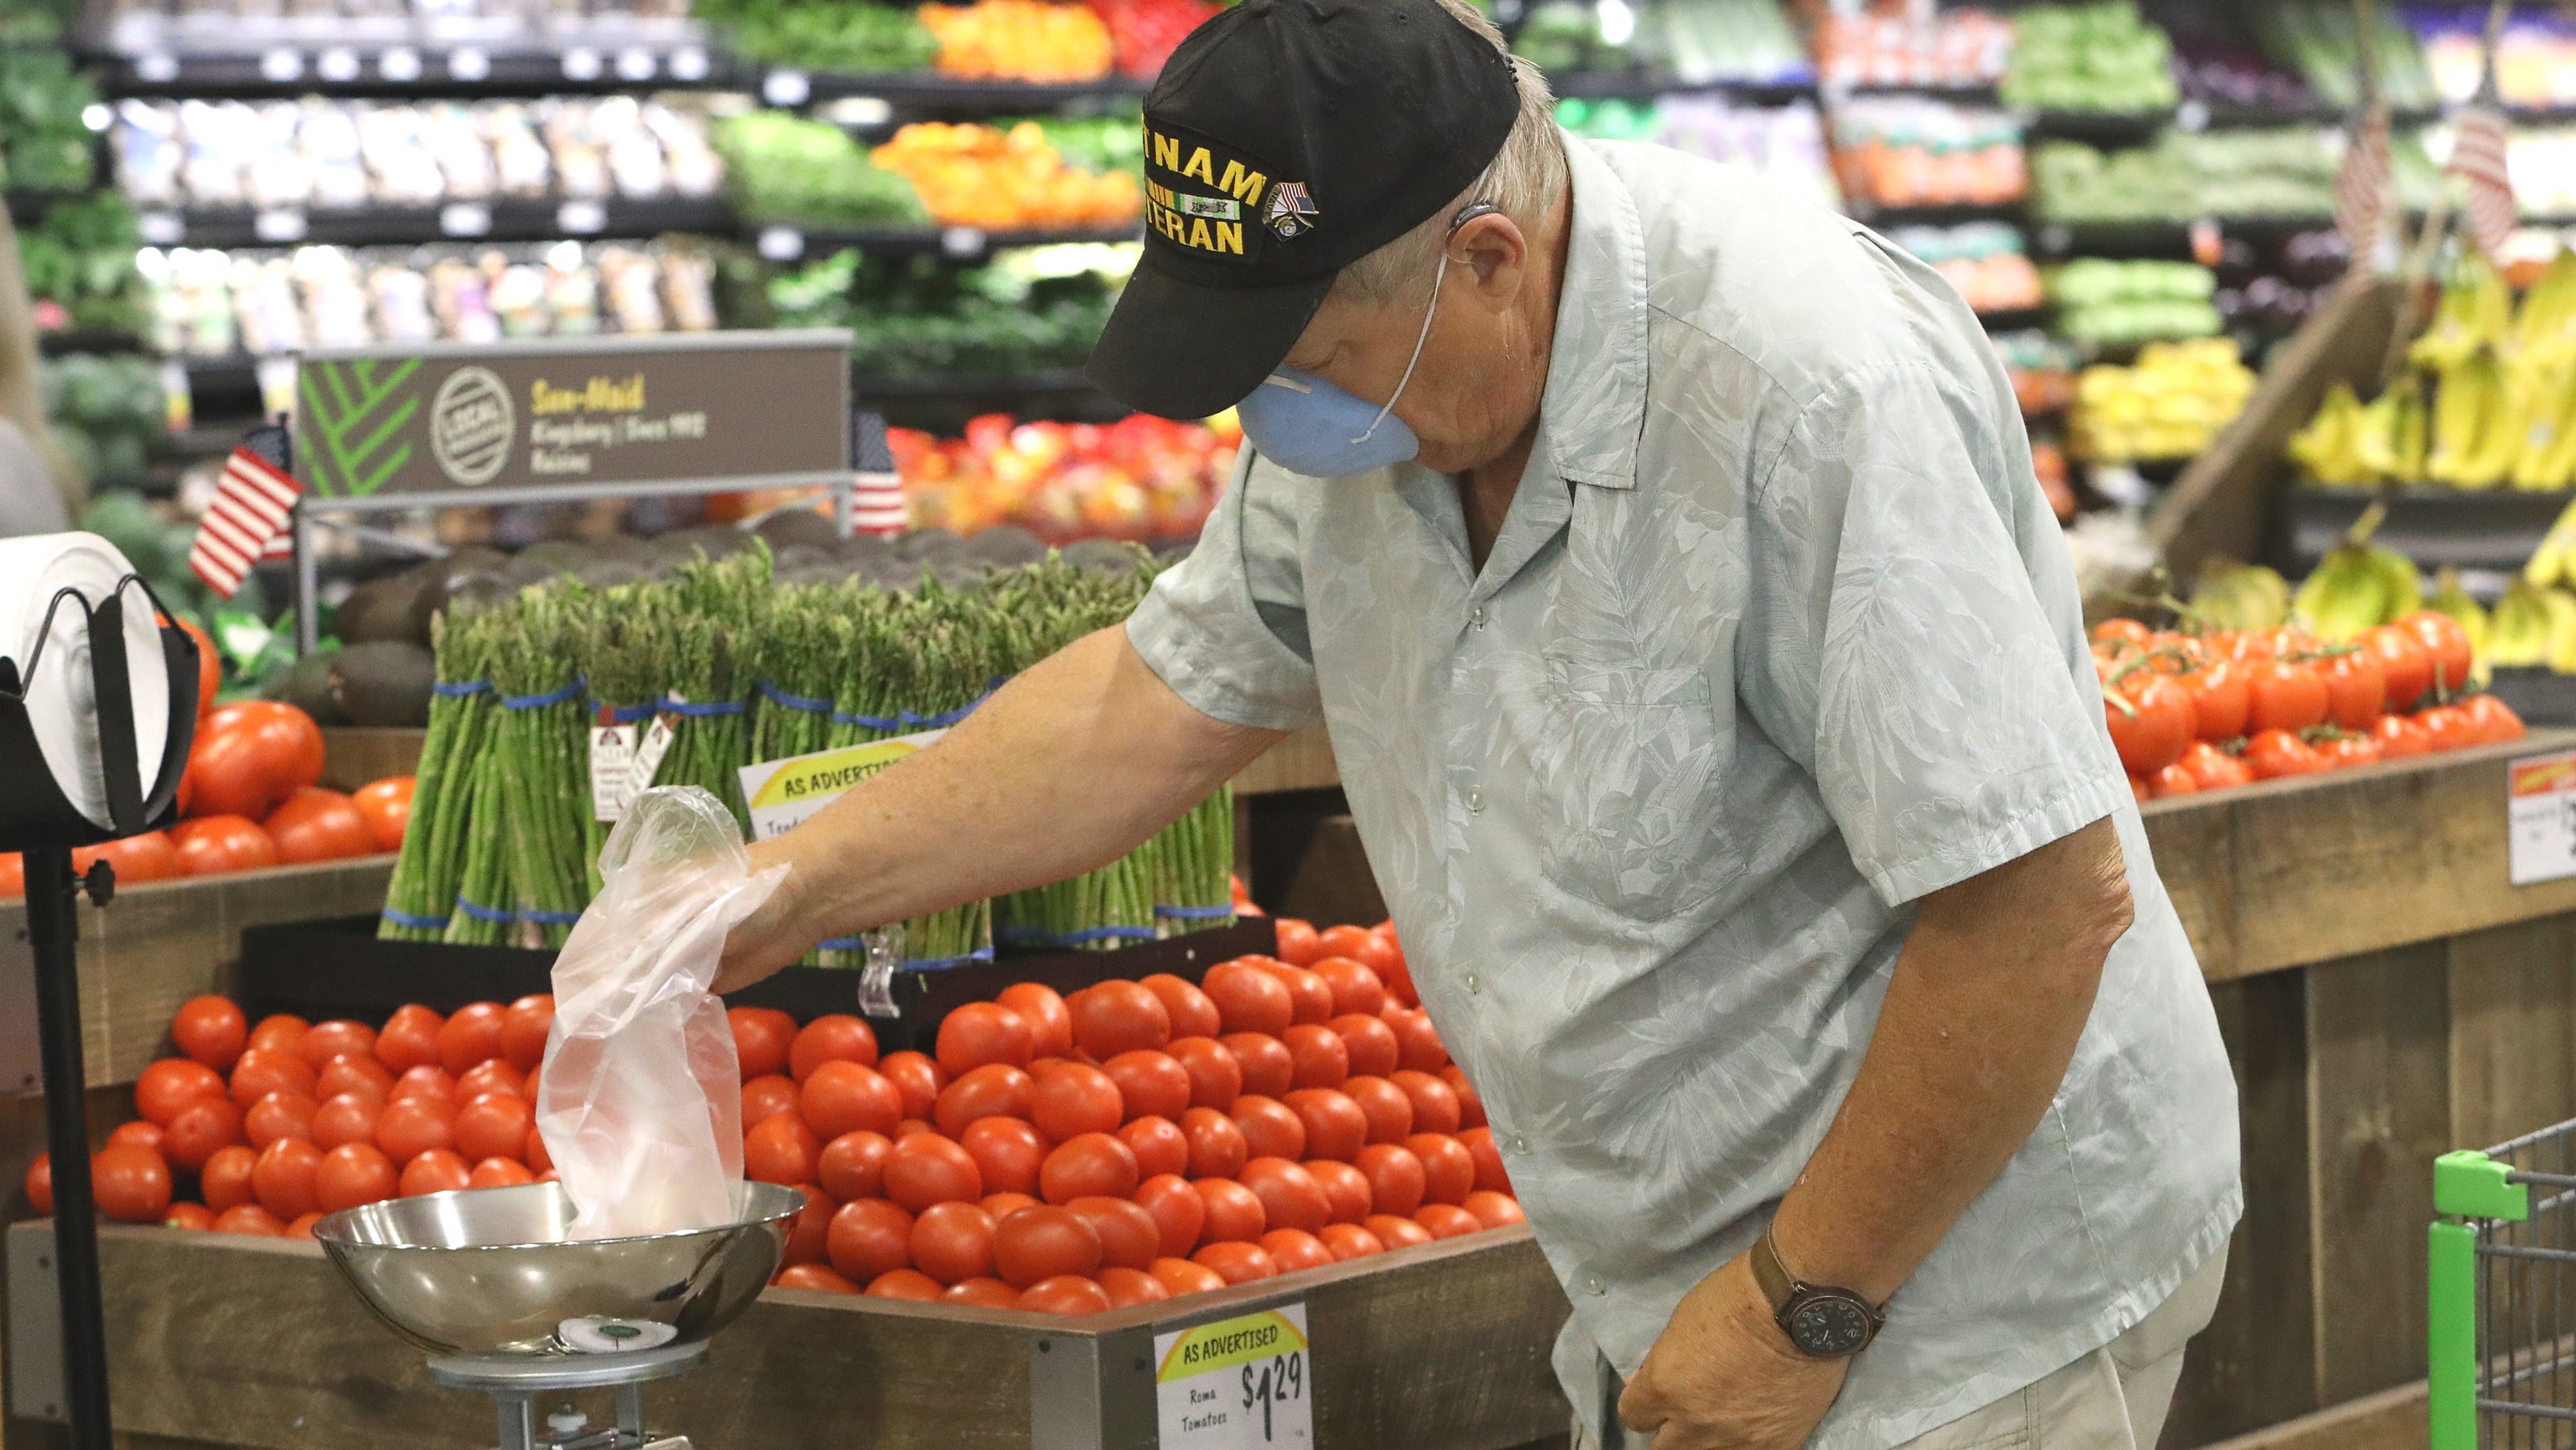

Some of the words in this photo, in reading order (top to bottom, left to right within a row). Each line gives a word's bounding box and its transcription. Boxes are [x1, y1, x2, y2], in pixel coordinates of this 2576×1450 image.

[1141, 114, 1267, 207] TNAM
[1146, 194, 1244, 255] TERAN
[784, 778, 805, 798] AS
[811, 759, 901, 791] ADVERTI
[767, 816, 802, 834] Tend
[1184, 1345, 1199, 1365] AS
[1203, 1325, 1278, 1360] ADVERTISED
[1190, 1388, 1216, 1404] Roma
[1182, 1412, 1227, 1431] Tomatoes
